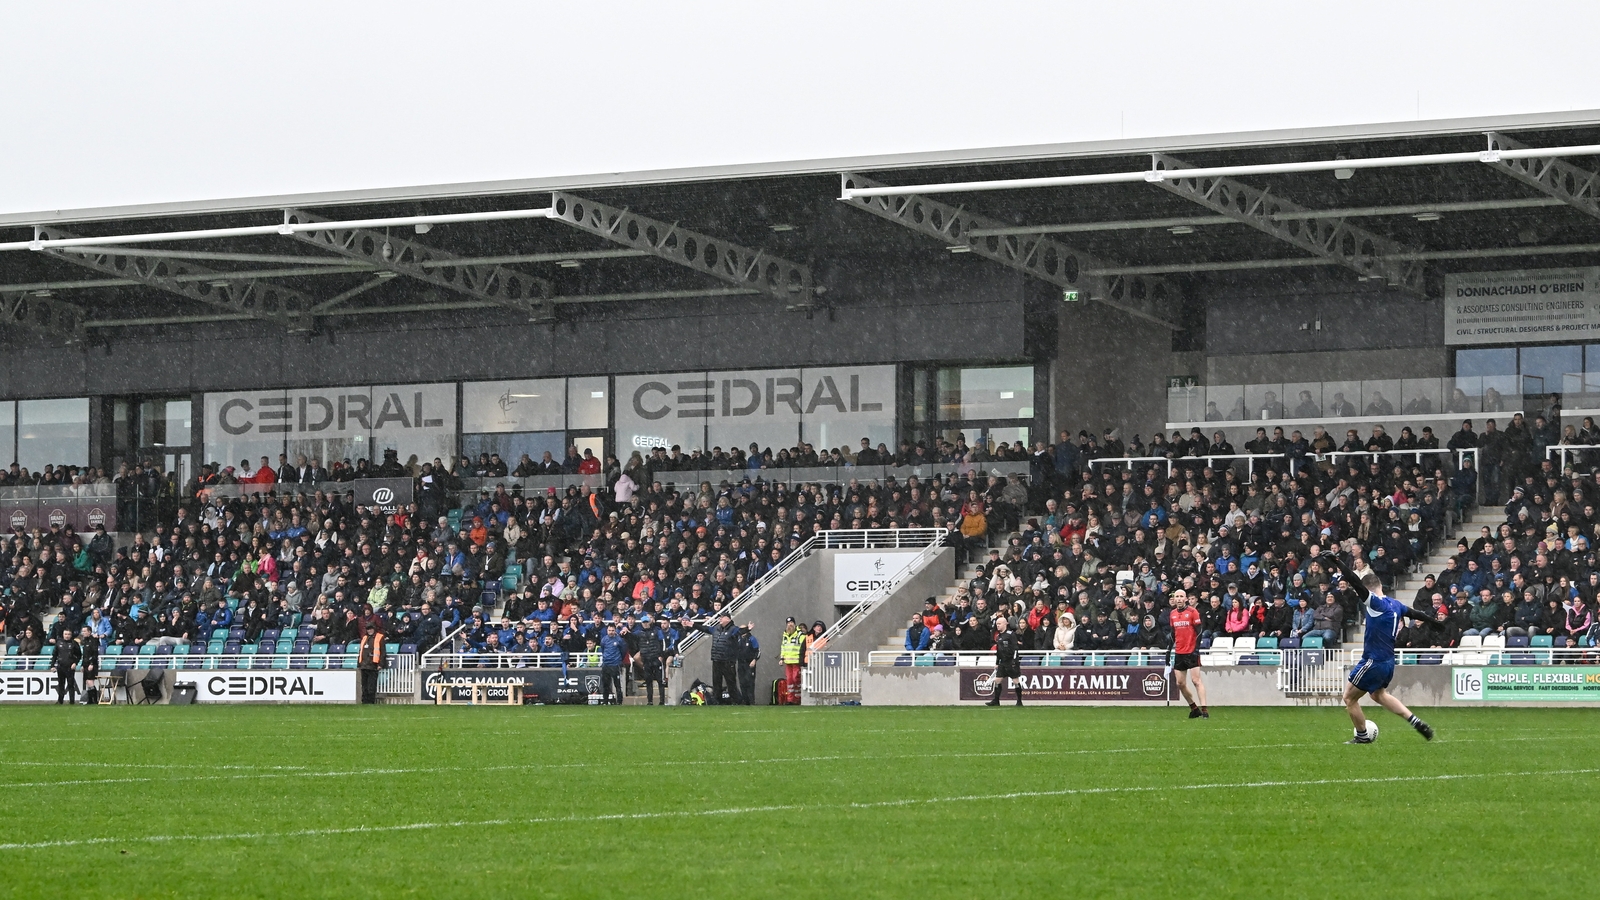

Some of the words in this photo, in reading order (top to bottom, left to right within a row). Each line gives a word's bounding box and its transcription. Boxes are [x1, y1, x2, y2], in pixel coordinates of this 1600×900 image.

[1456, 284, 1536, 297] DONNACHADH
[1540, 282, 1585, 294] O'BRIEN
[1456, 306, 1462, 314] &
[1463, 304, 1500, 314] ASSOCIATES
[1501, 302, 1544, 312] CONSULTING
[1546, 300, 1585, 310] ENGINEERS
[1477, 326, 1518, 335] STRUCTURAL
[1519, 325, 1555, 333] DESIGNERS
[1555, 324, 1561, 332] &
[1561, 323, 1590, 331] PROJECT
[632, 374, 883, 420] CEDRAL
[218, 391, 444, 436] CEDRAL
[633, 436, 671, 448] CEDRAL
[1391, 611, 1398, 637] 1
[207, 676, 324, 696] CEDRAL
[450, 677, 473, 688] JOE
[476, 676, 525, 688] MALLON
[1069, 674, 1130, 690] FAMILY
[1456, 673, 1480, 695] life
[1487, 674, 1530, 684] SIMPLE,
[1534, 674, 1583, 684] FLEXIBLE
